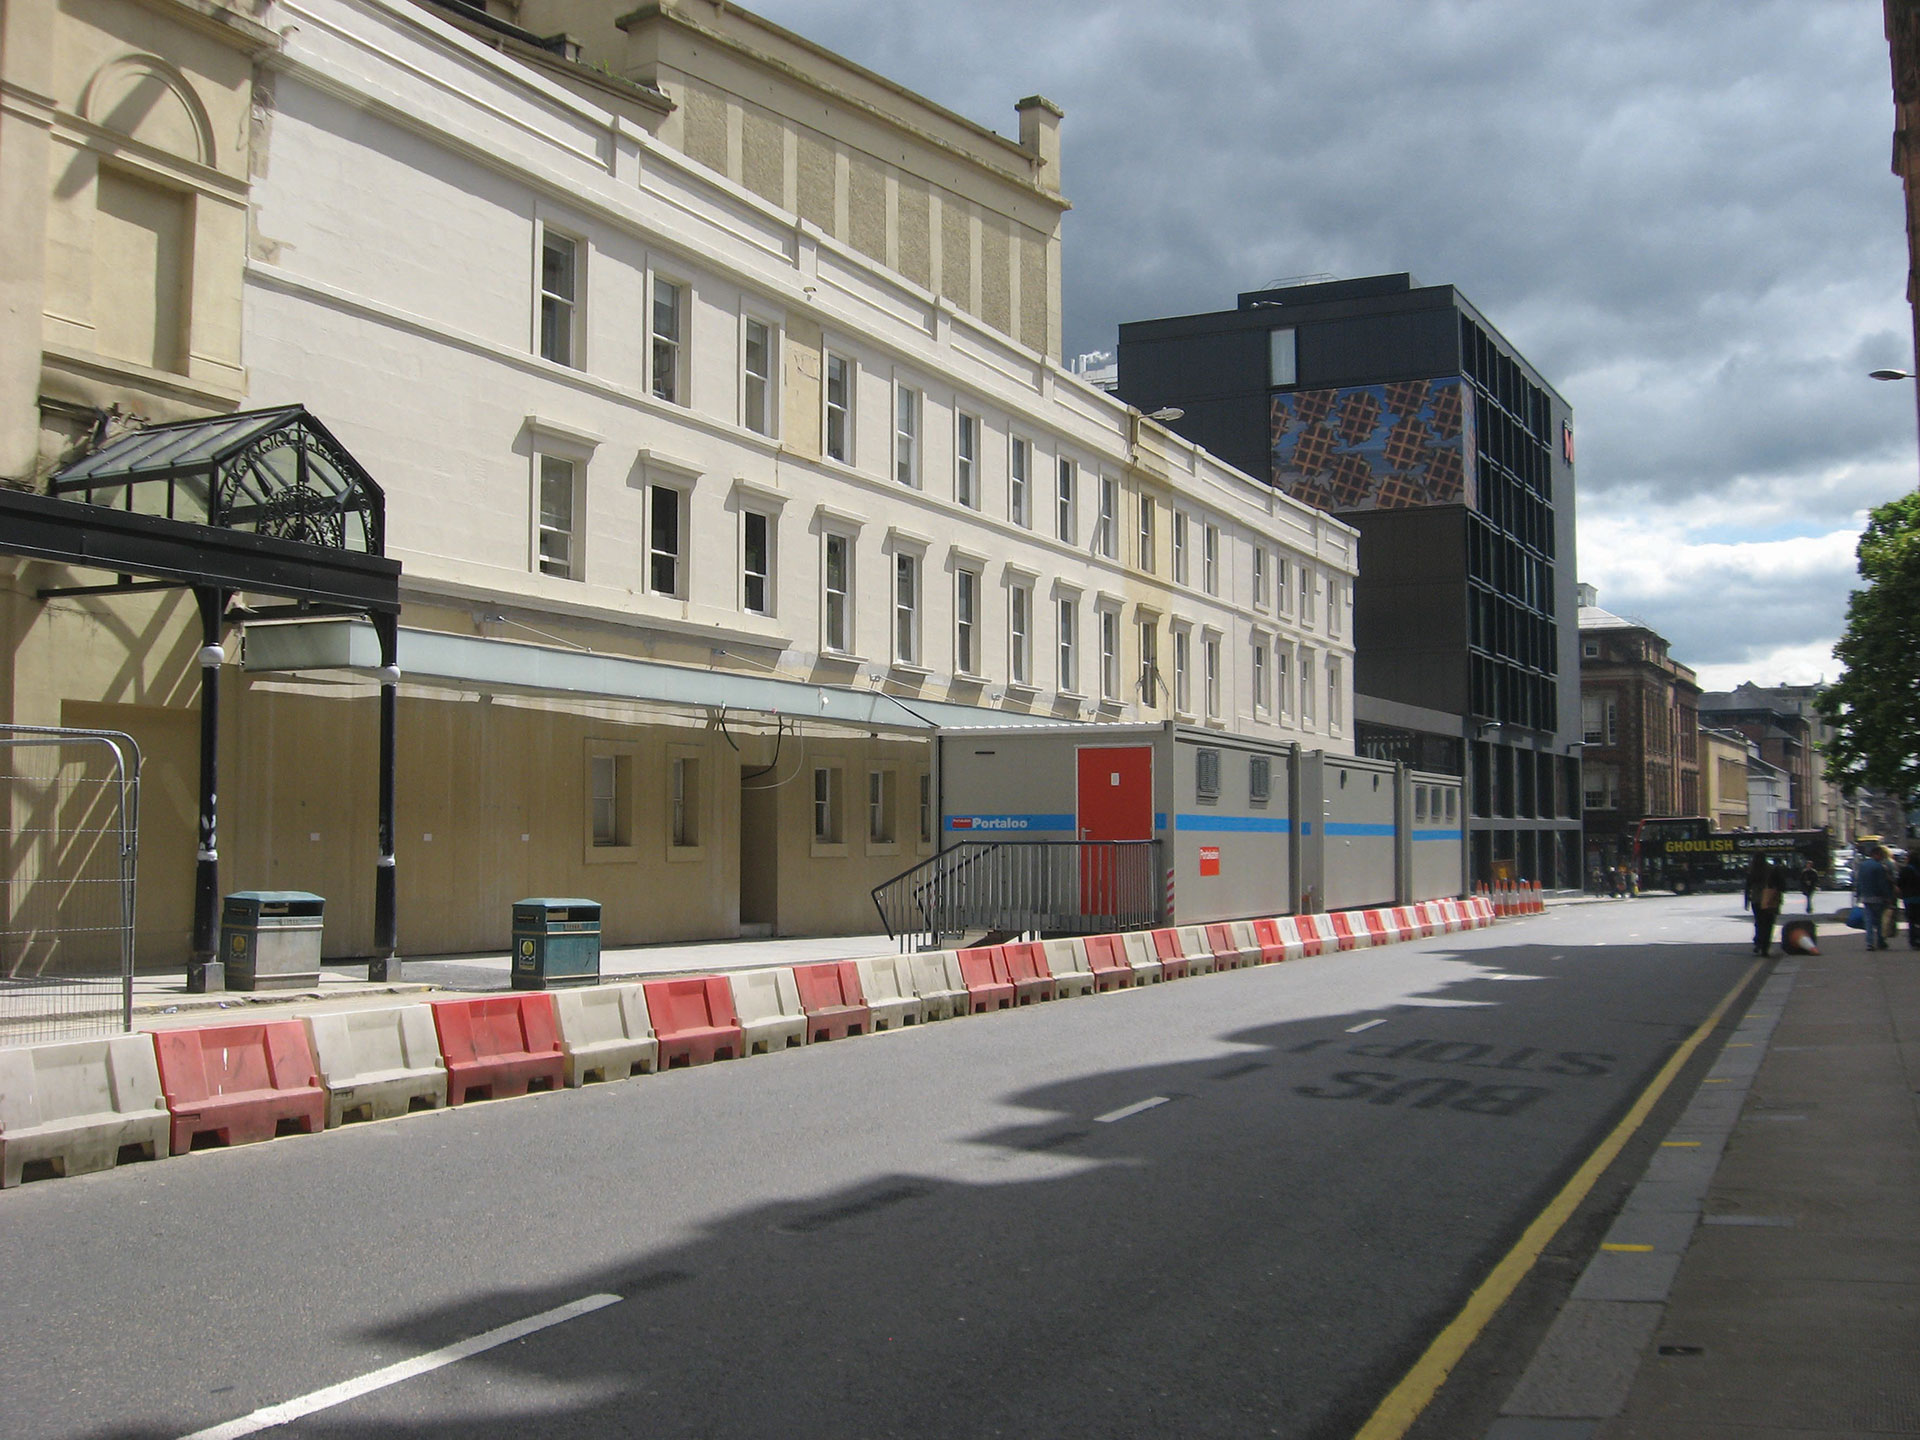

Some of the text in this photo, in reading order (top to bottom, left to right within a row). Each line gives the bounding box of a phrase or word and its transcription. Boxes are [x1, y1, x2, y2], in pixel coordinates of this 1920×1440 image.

[972, 817, 1028, 828] Portaloo
[1665, 839, 1734, 852] GHOULISH
[1738, 838, 1795, 847] GLASGOW
[1348, 1039, 1617, 1076] STOP
[1293, 1071, 1550, 1117] BUS
